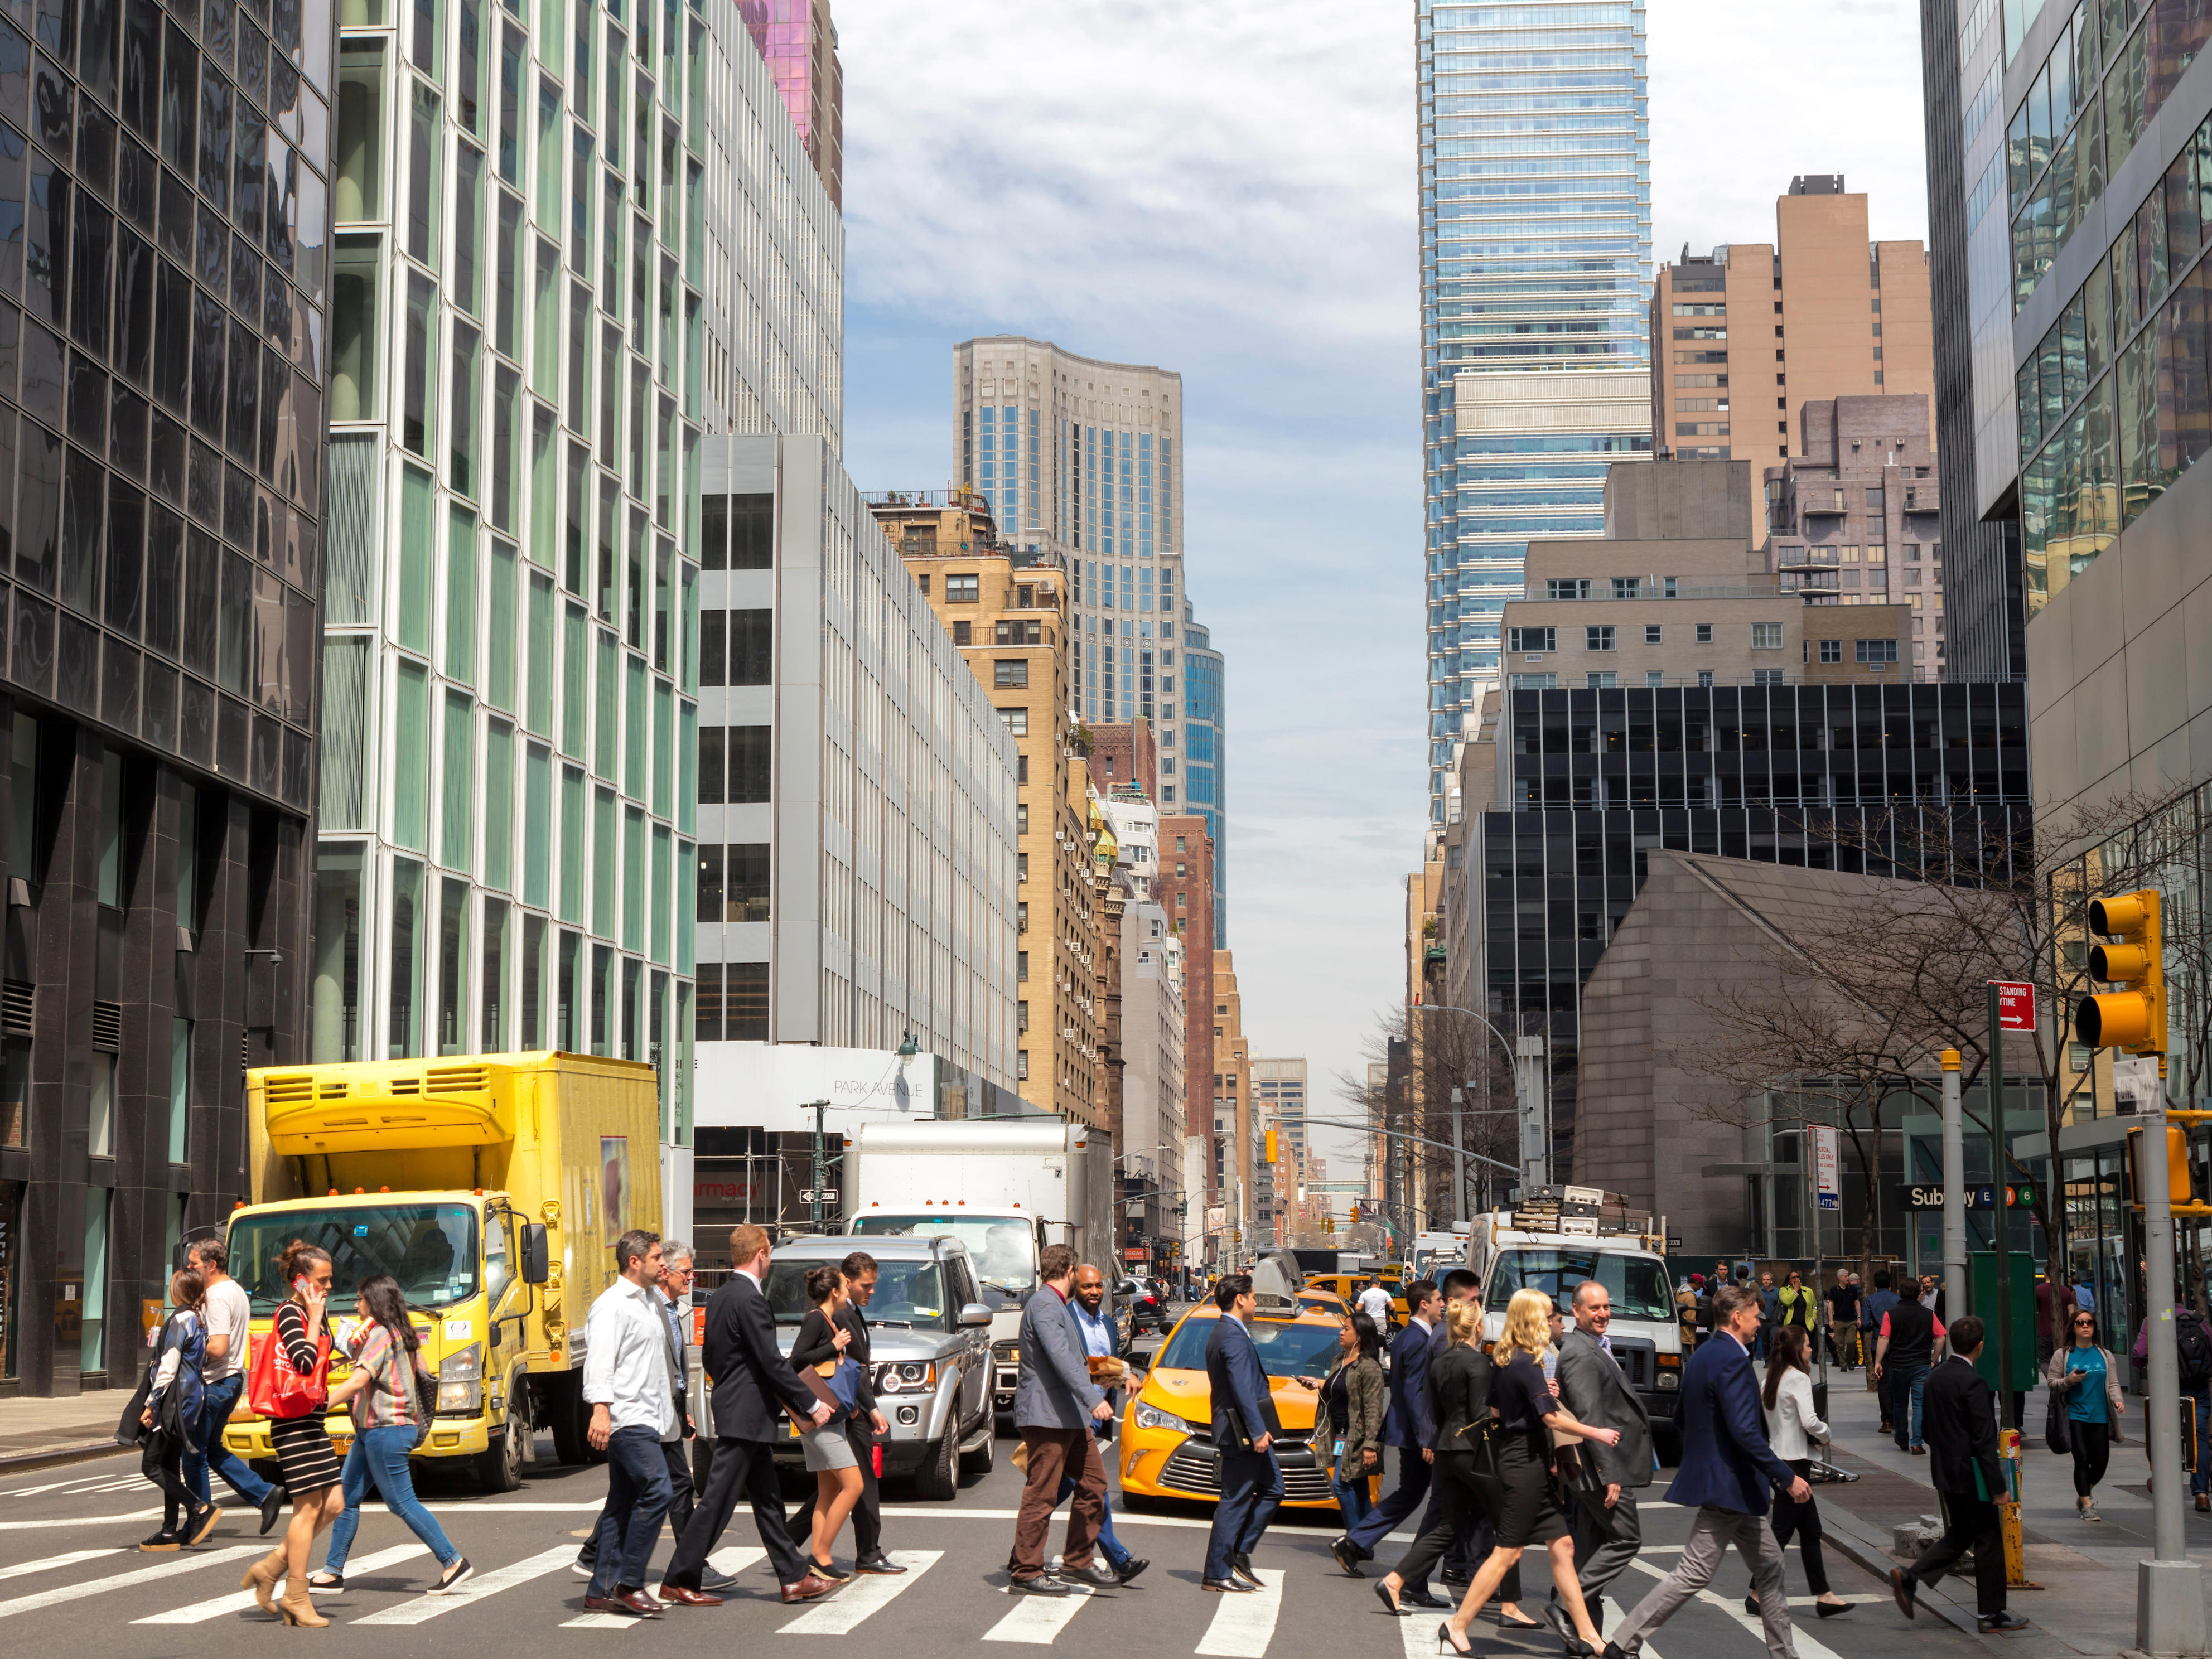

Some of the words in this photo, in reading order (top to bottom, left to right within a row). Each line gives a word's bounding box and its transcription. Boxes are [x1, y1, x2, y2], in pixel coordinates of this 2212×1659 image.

[1999, 986, 2027, 997] STANDING
[1999, 997, 2016, 1007] YTIME
[834, 1080, 867, 1095] PARK
[872, 1082, 923, 1097] AVENUE
[2120, 1078, 2133, 1100] ONE
[2138, 1076, 2153, 1098] WAY
[1911, 1187, 1976, 1208] Suby
[1984, 1192, 1991, 1201] E
[2024, 1191, 2030, 1201] 6
